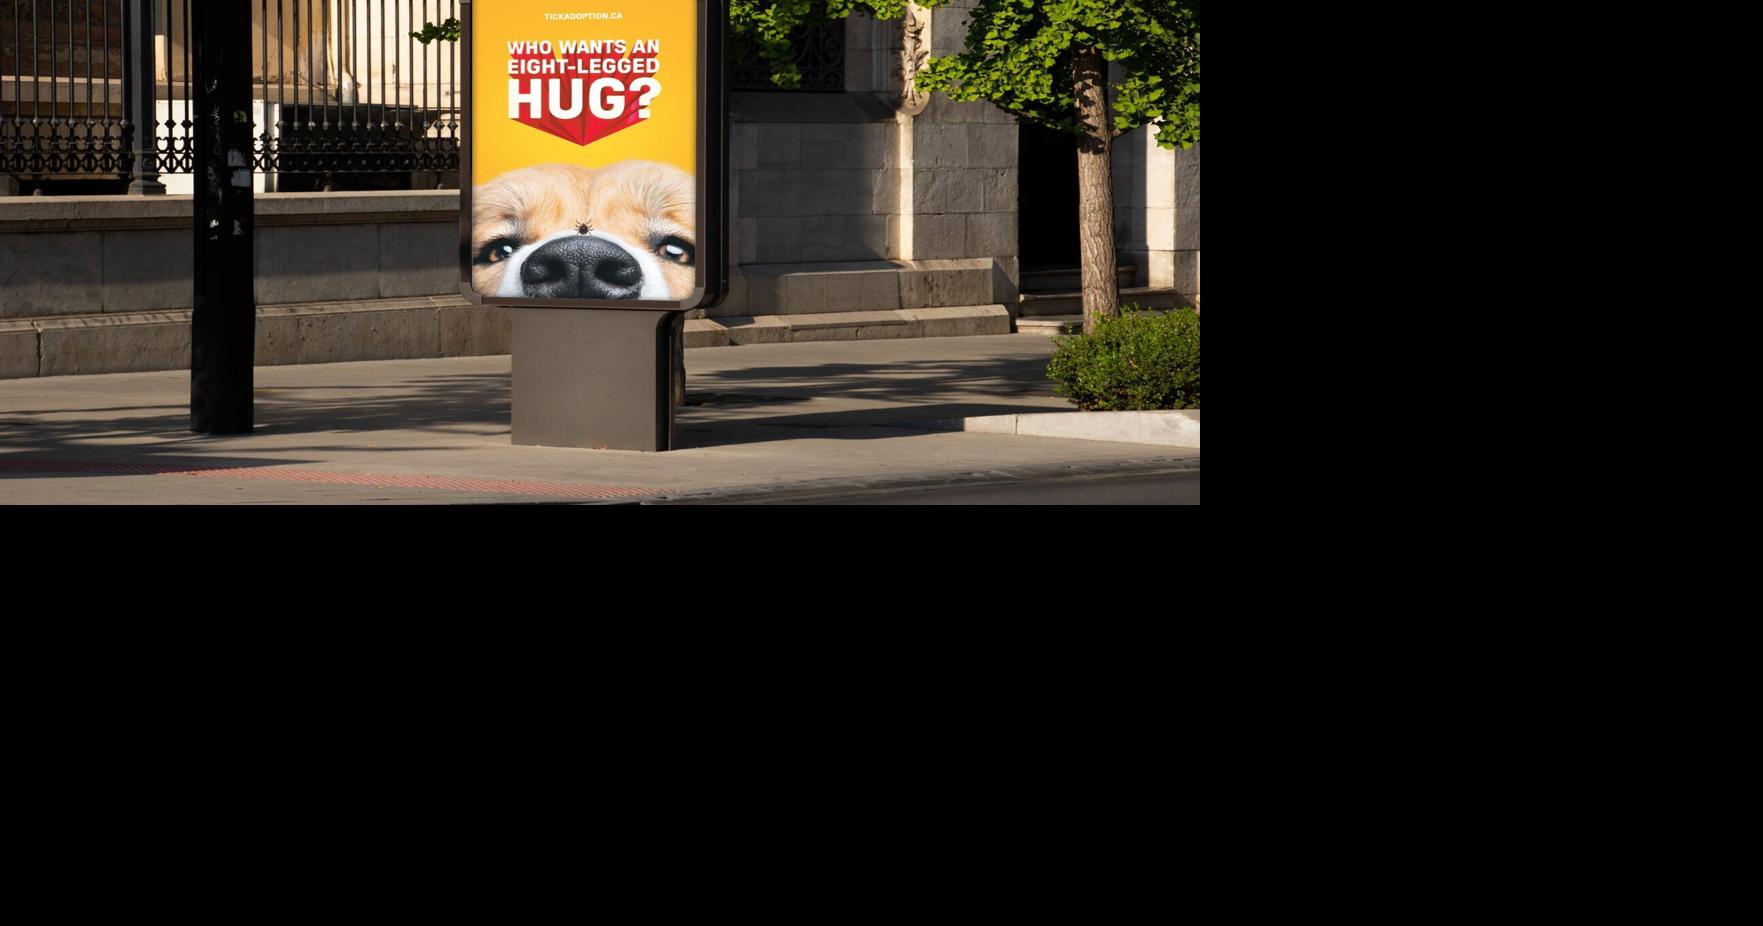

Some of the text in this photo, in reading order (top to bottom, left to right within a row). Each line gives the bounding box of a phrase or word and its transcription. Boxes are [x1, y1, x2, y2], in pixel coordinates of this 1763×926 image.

[544, 12, 623, 20] TICKADOPTION.CA
[507, 39, 660, 54] WHO WANTS AN
[507, 58, 660, 75] EIGHT-LEGGED
[507, 77, 662, 120] HUG?
